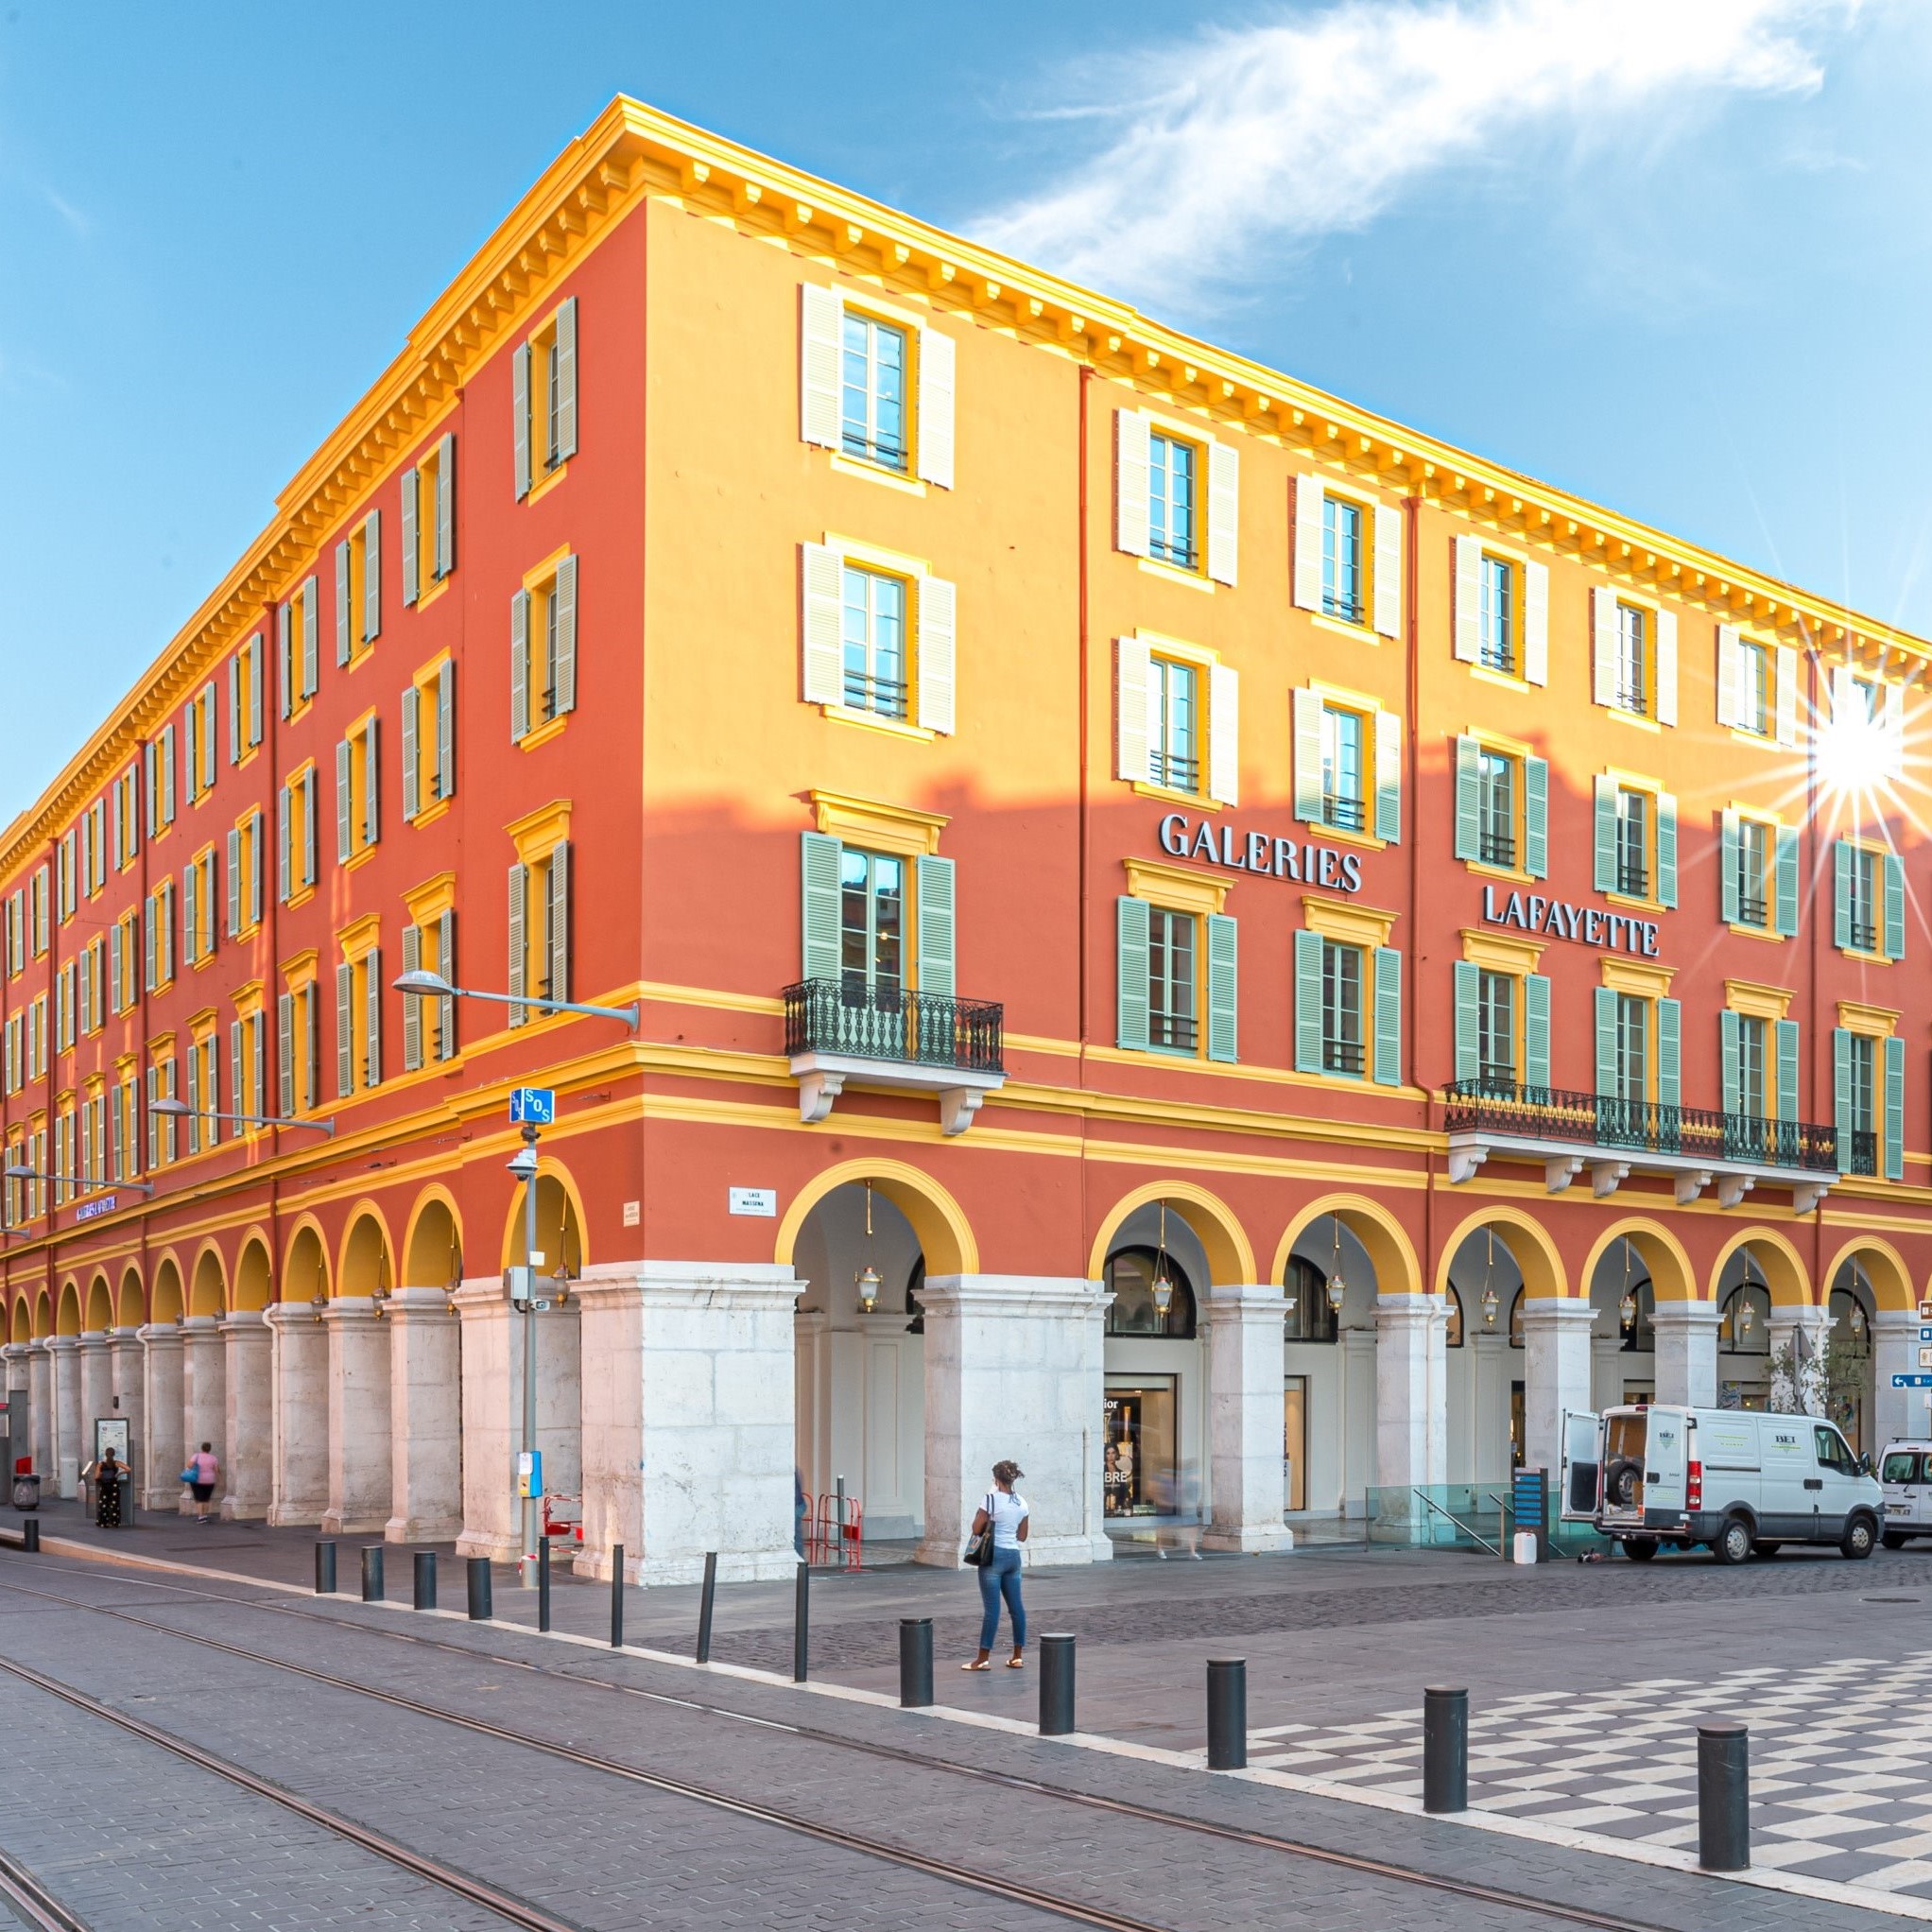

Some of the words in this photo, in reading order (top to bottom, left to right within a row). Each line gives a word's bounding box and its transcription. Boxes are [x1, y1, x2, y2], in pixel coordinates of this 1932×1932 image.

[1159, 813, 1362, 893] GALERIES
[1483, 885, 1660, 957] LAFAYETTE
[525, 1089, 551, 1122] SOS
[1103, 1398, 1119, 1409] ior
[1104, 1471, 1129, 1483] BRE
